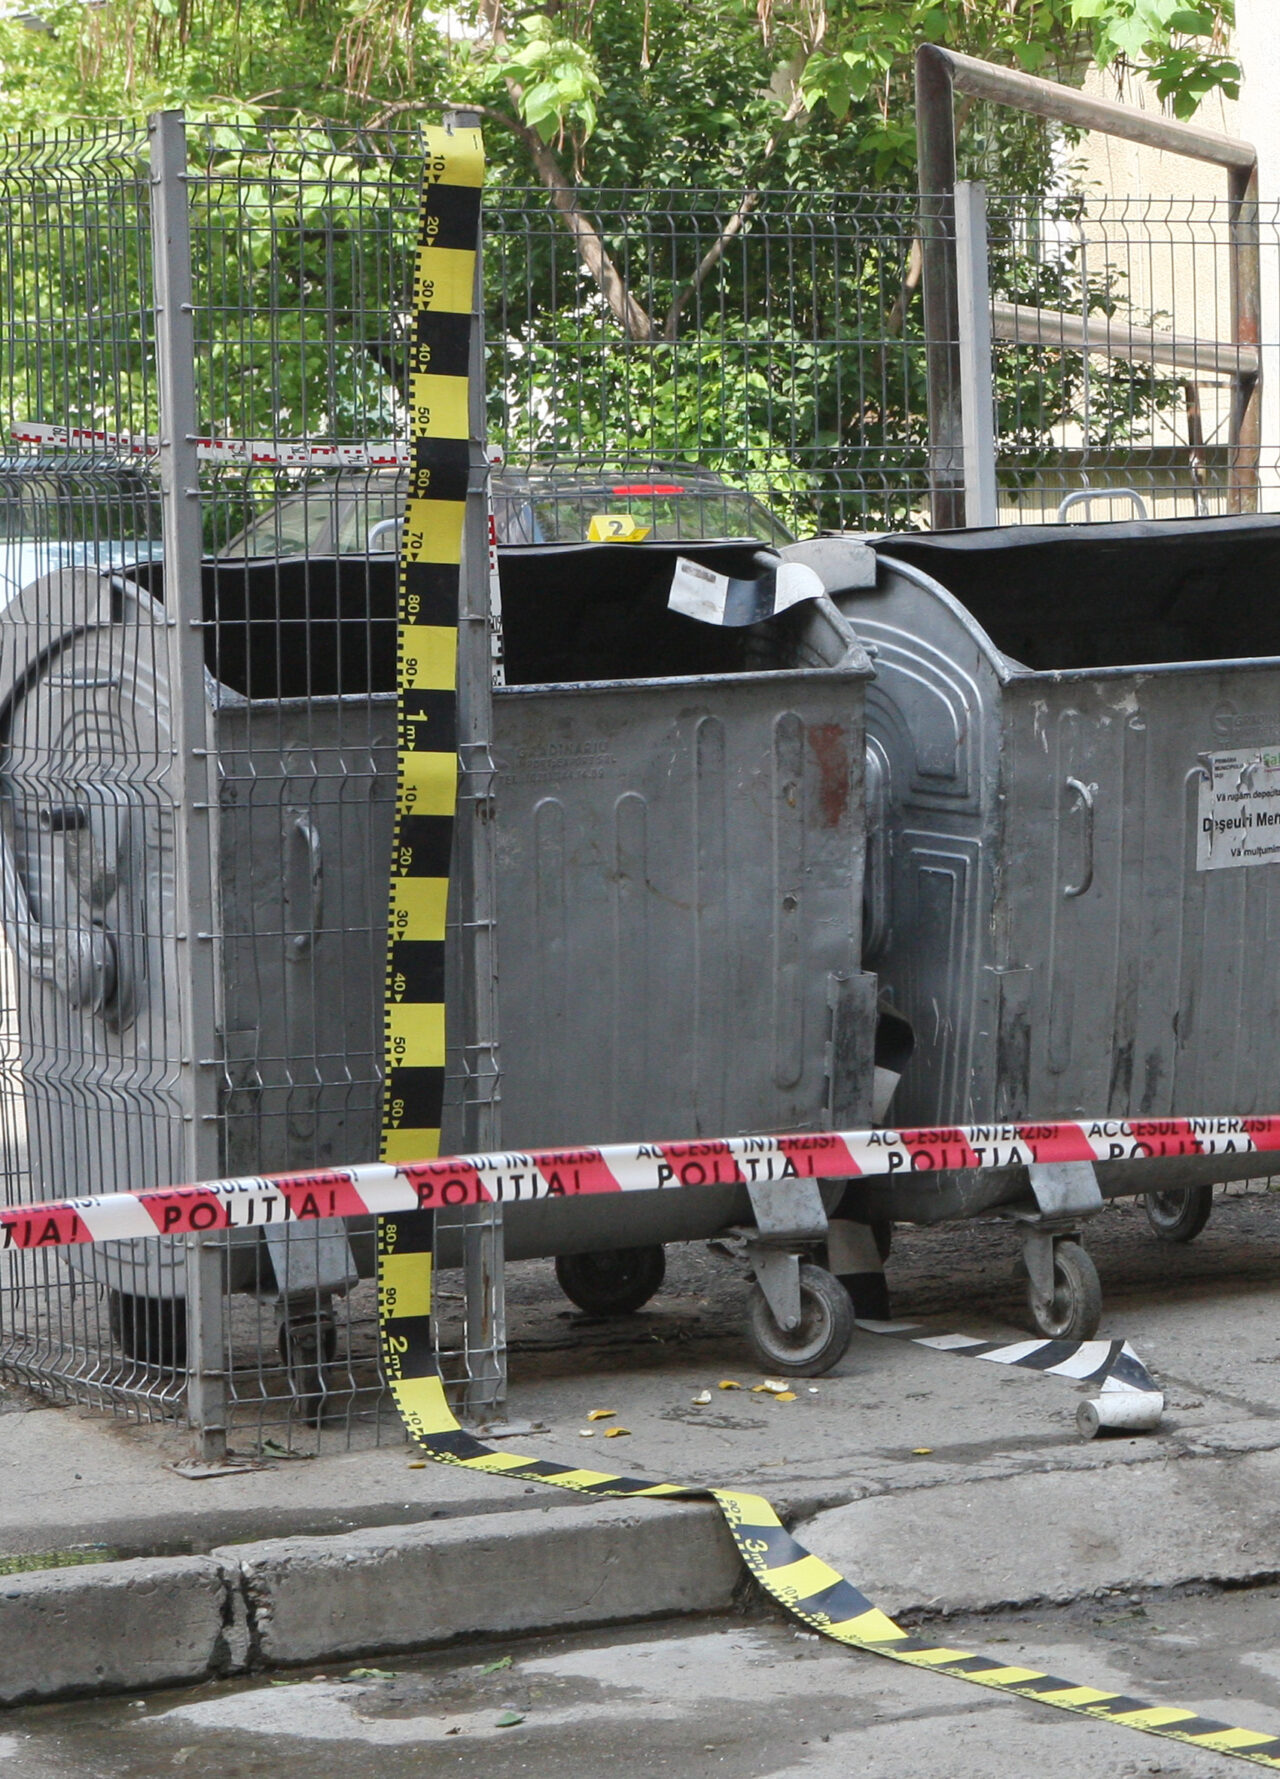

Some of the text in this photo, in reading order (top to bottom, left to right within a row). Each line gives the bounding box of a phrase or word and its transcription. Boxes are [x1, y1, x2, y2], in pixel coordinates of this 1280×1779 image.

[432, 154, 446, 172] 10
[427, 216, 440, 235] 20
[422, 280, 434, 298] 30
[419, 343, 431, 362] 40
[418, 406, 430, 425] 50
[418, 469, 430, 487] 60
[608, 520, 624, 536] 2
[410, 532, 423, 550] 70
[408, 594, 420, 613] 80
[405, 658, 418, 676] 90
[404, 785, 417, 802] 10
[400, 847, 412, 866] 20
[396, 909, 408, 928] 30
[393, 972, 406, 991] 40
[393, 1036, 406, 1055] 50
[391, 1099, 404, 1118] 60
[636, 1138, 735, 1160] ACCESUL
[743, 1134, 837, 1154] INTERZIS!
[866, 1129, 964, 1148] ACCESUL
[969, 1124, 1060, 1143] INTERZIS!
[1088, 1119, 1181, 1138] ACCESUL
[1187, 1116, 1273, 1135] INTERZIS!
[162, 1190, 337, 1233] POLITIA!
[417, 1172, 581, 1210] POLITIA!
[657, 1155, 814, 1189] POLITIA!
[888, 1145, 1038, 1174] POLITIA!
[385, 1224, 397, 1242] 80
[385, 1287, 397, 1305] 90
[407, 1410, 422, 1426] 10
